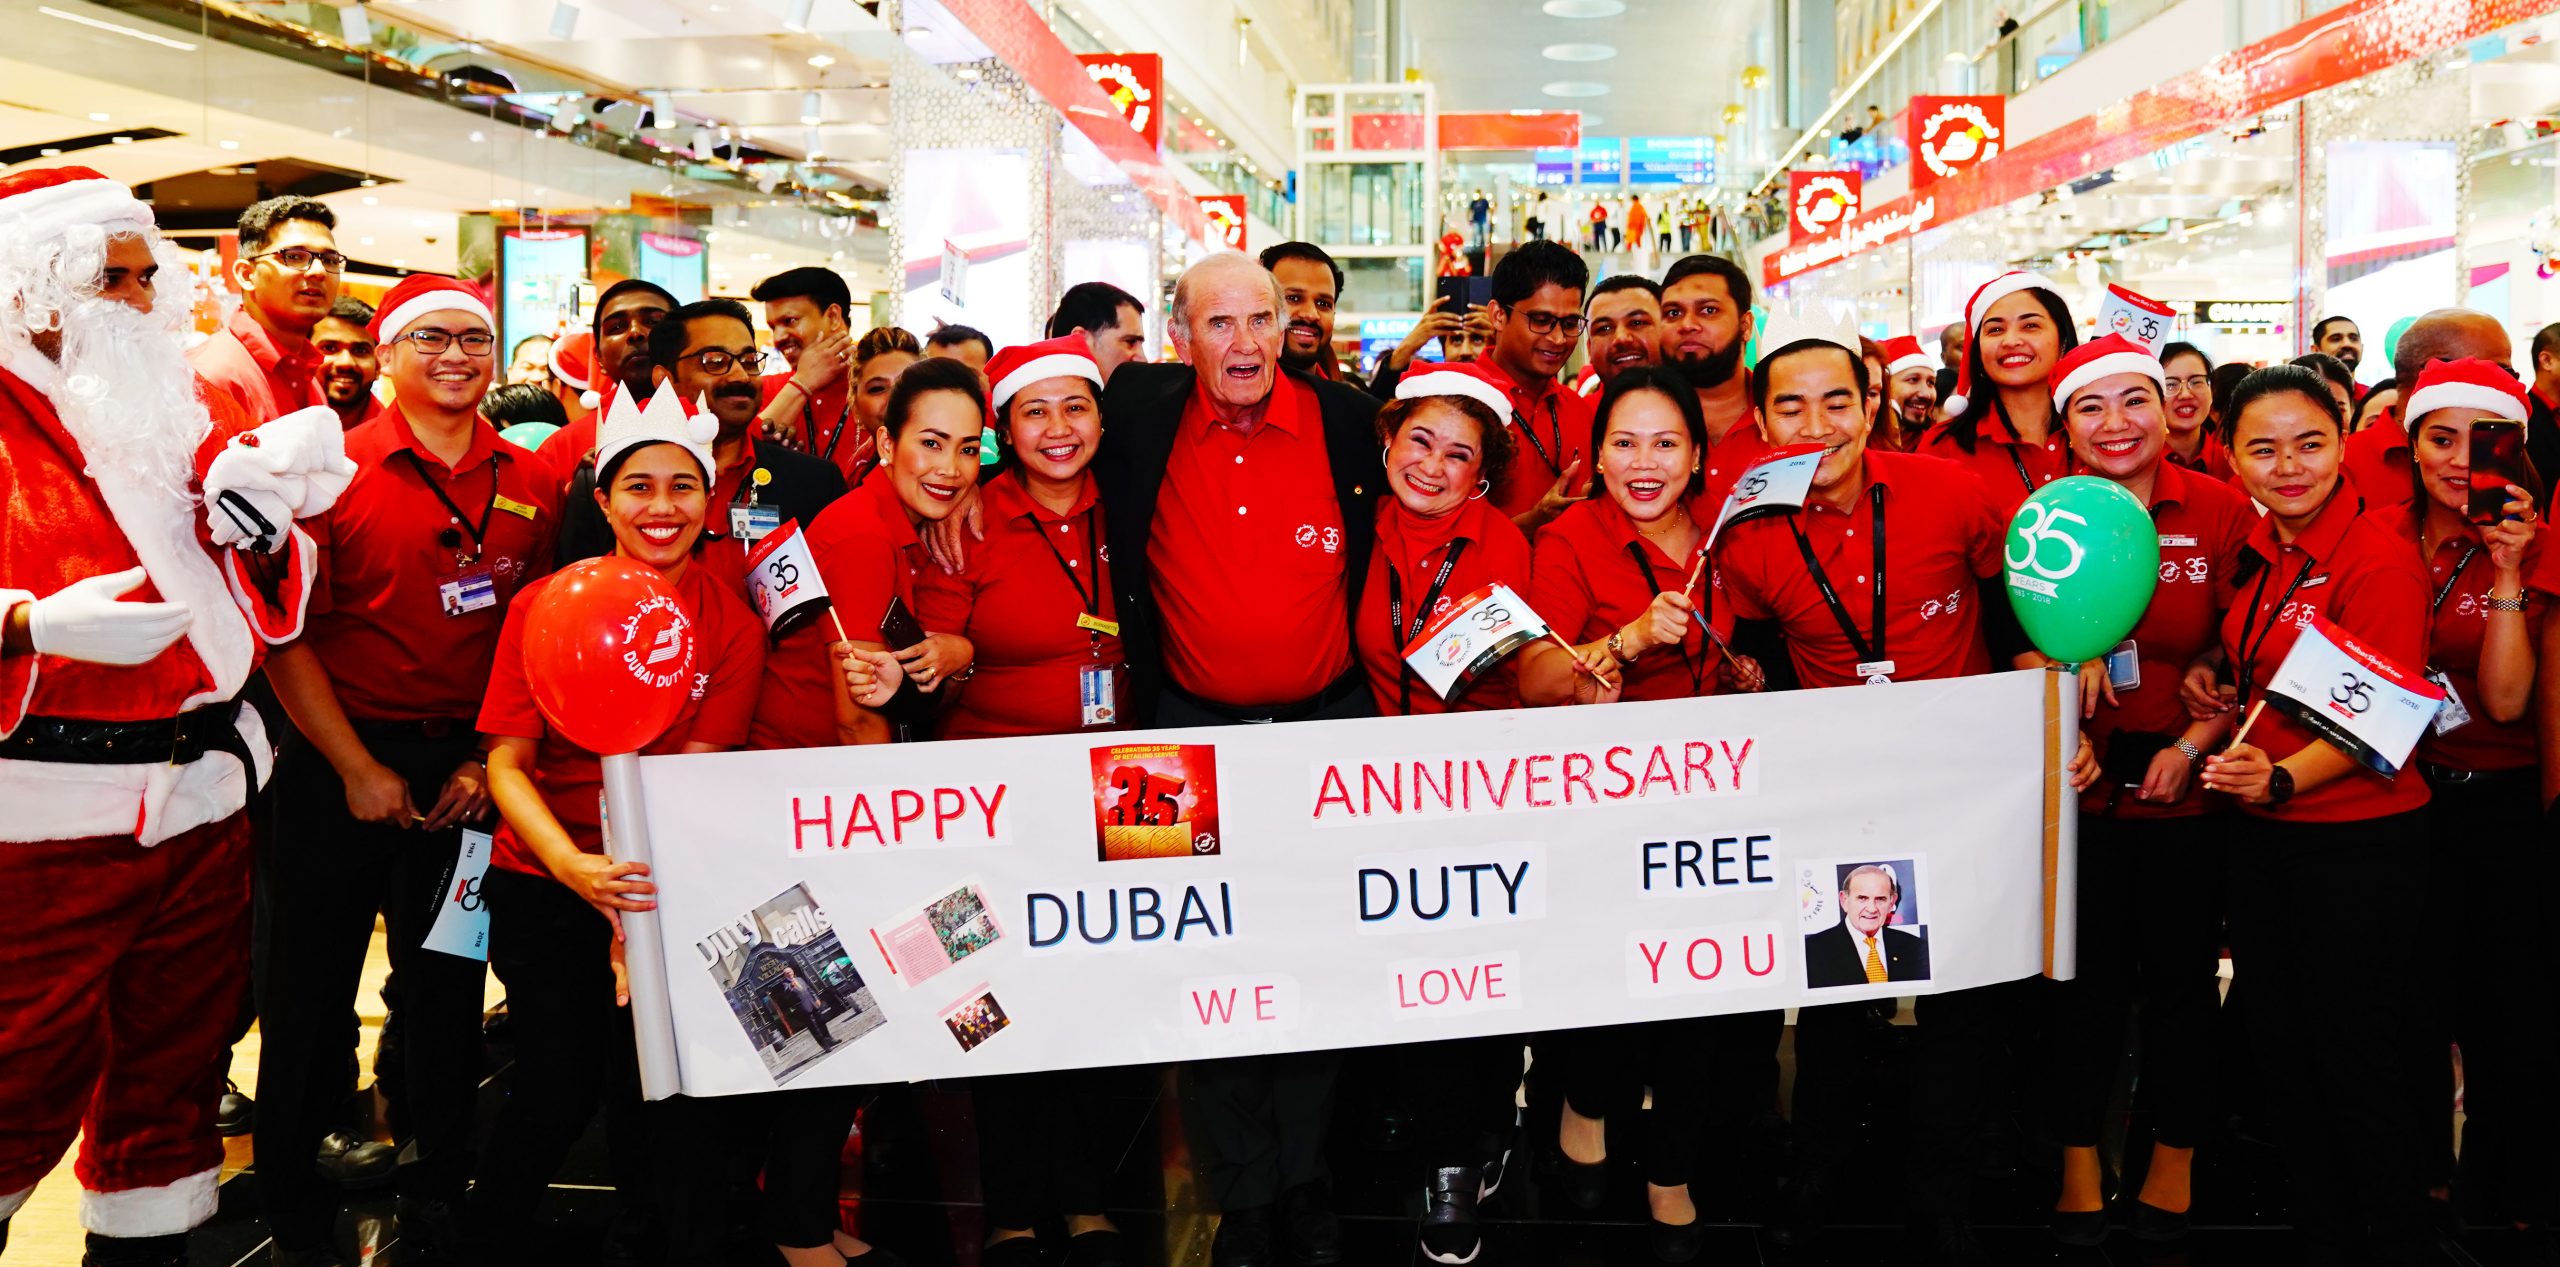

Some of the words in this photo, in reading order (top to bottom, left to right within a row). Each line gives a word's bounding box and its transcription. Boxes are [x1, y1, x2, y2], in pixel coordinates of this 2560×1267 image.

[2138, 317, 2159, 340] 35
[2208, 302, 2292, 322] CHAN
[1321, 526, 1340, 547] 35
[2005, 502, 2088, 580] 35
[768, 554, 799, 593] 35
[2014, 573, 2047, 592] YEARS
[2185, 556, 2209, 578] 35
[2032, 592, 2052, 605] 2018
[2296, 603, 2316, 624] 35
[1471, 603, 1511, 631] 35
[623, 650, 655, 686] DUBAI
[656, 666, 684, 688] DUTY
[684, 636, 694, 668] FREE
[2330, 671, 2377, 714] 35
[792, 783, 1008, 852] HAPPY
[1312, 737, 1755, 820] ANNIVERSARY
[1107, 765, 1187, 827] 35
[1027, 882, 1233, 949] DUBAI
[1357, 860, 1531, 923] DUTY
[1643, 834, 1774, 891] FREE
[474, 931, 485, 948] 2018
[771, 904, 833, 950] calls
[1192, 985, 1275, 1026] WE
[1397, 963, 1506, 1010] LOVE
[1639, 933, 1777, 984] YOU
